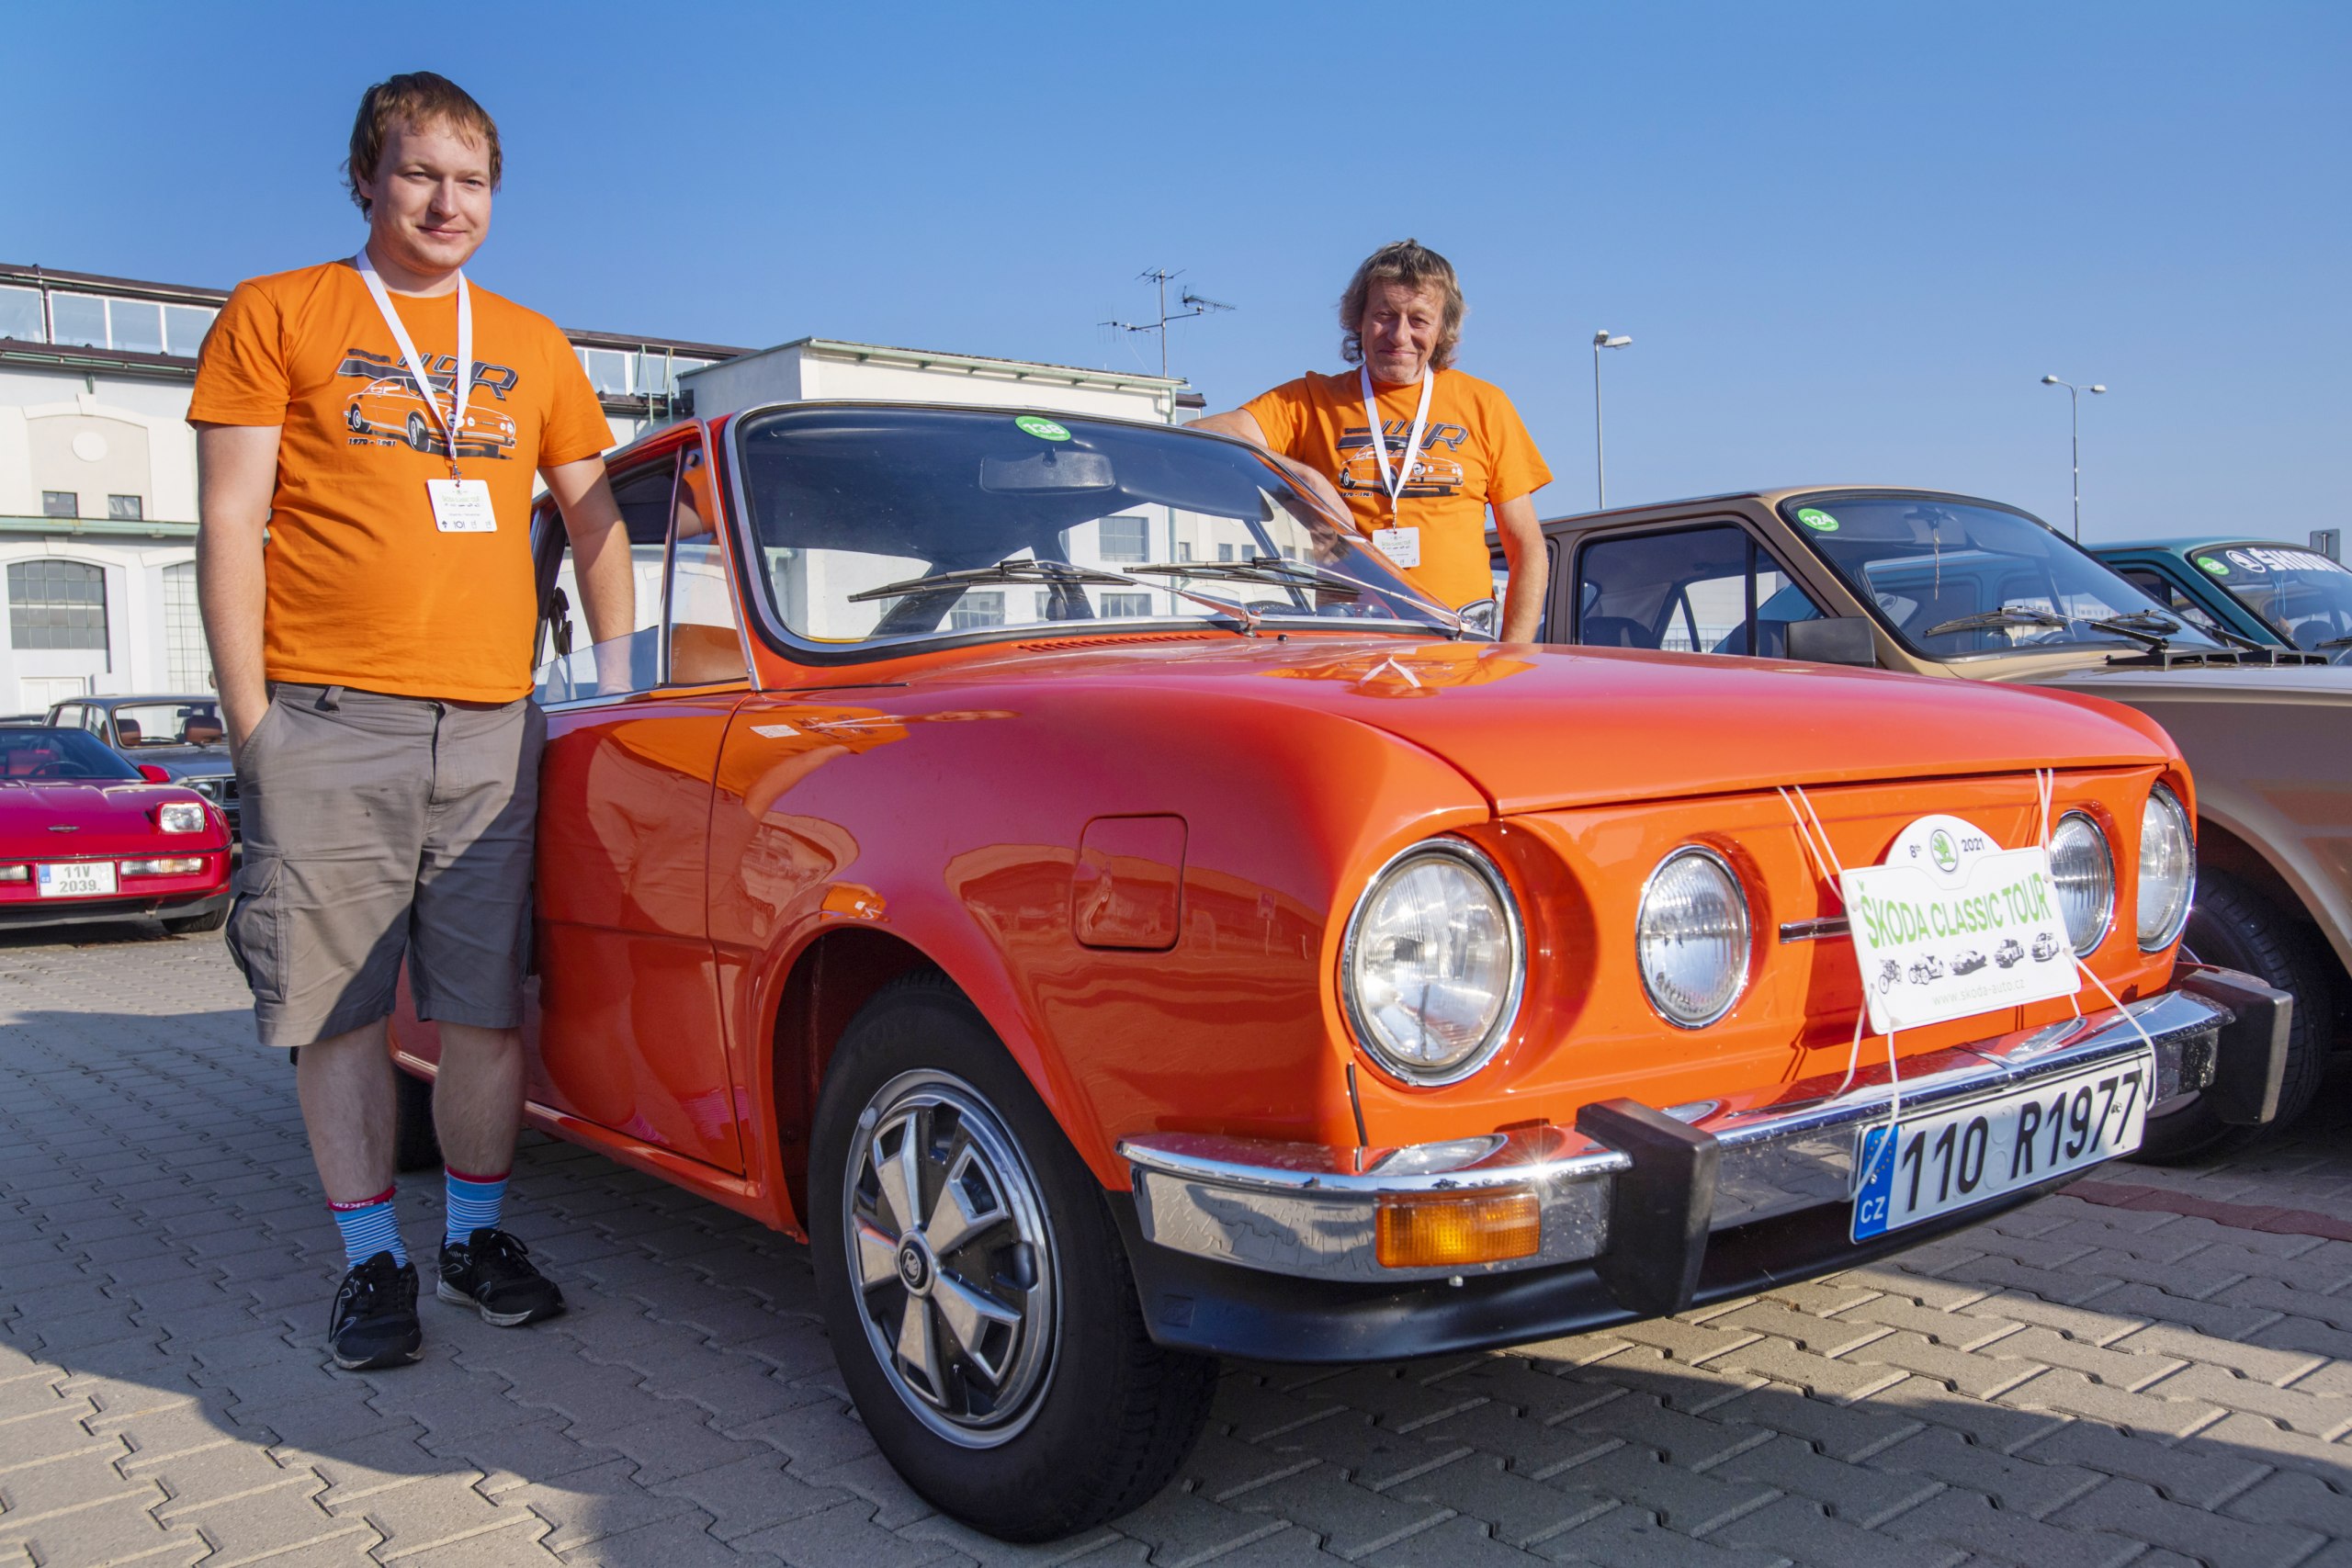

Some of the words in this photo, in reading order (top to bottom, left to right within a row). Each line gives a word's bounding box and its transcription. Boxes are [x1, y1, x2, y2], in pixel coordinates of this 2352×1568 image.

[1022, 423, 1066, 434] 138
[1804, 514, 1835, 526] 124
[1961, 837, 1985, 852] 2021
[64, 865, 90, 878] 11V
[1856, 879, 1930, 950] ŠKODA
[1929, 892, 2004, 938] CLASSIC
[2001, 873, 2052, 926] TOUR
[1900, 1116, 1989, 1213] 110
[2009, 1069, 2143, 1181] R1977
[1860, 1196, 1886, 1224] CZ
